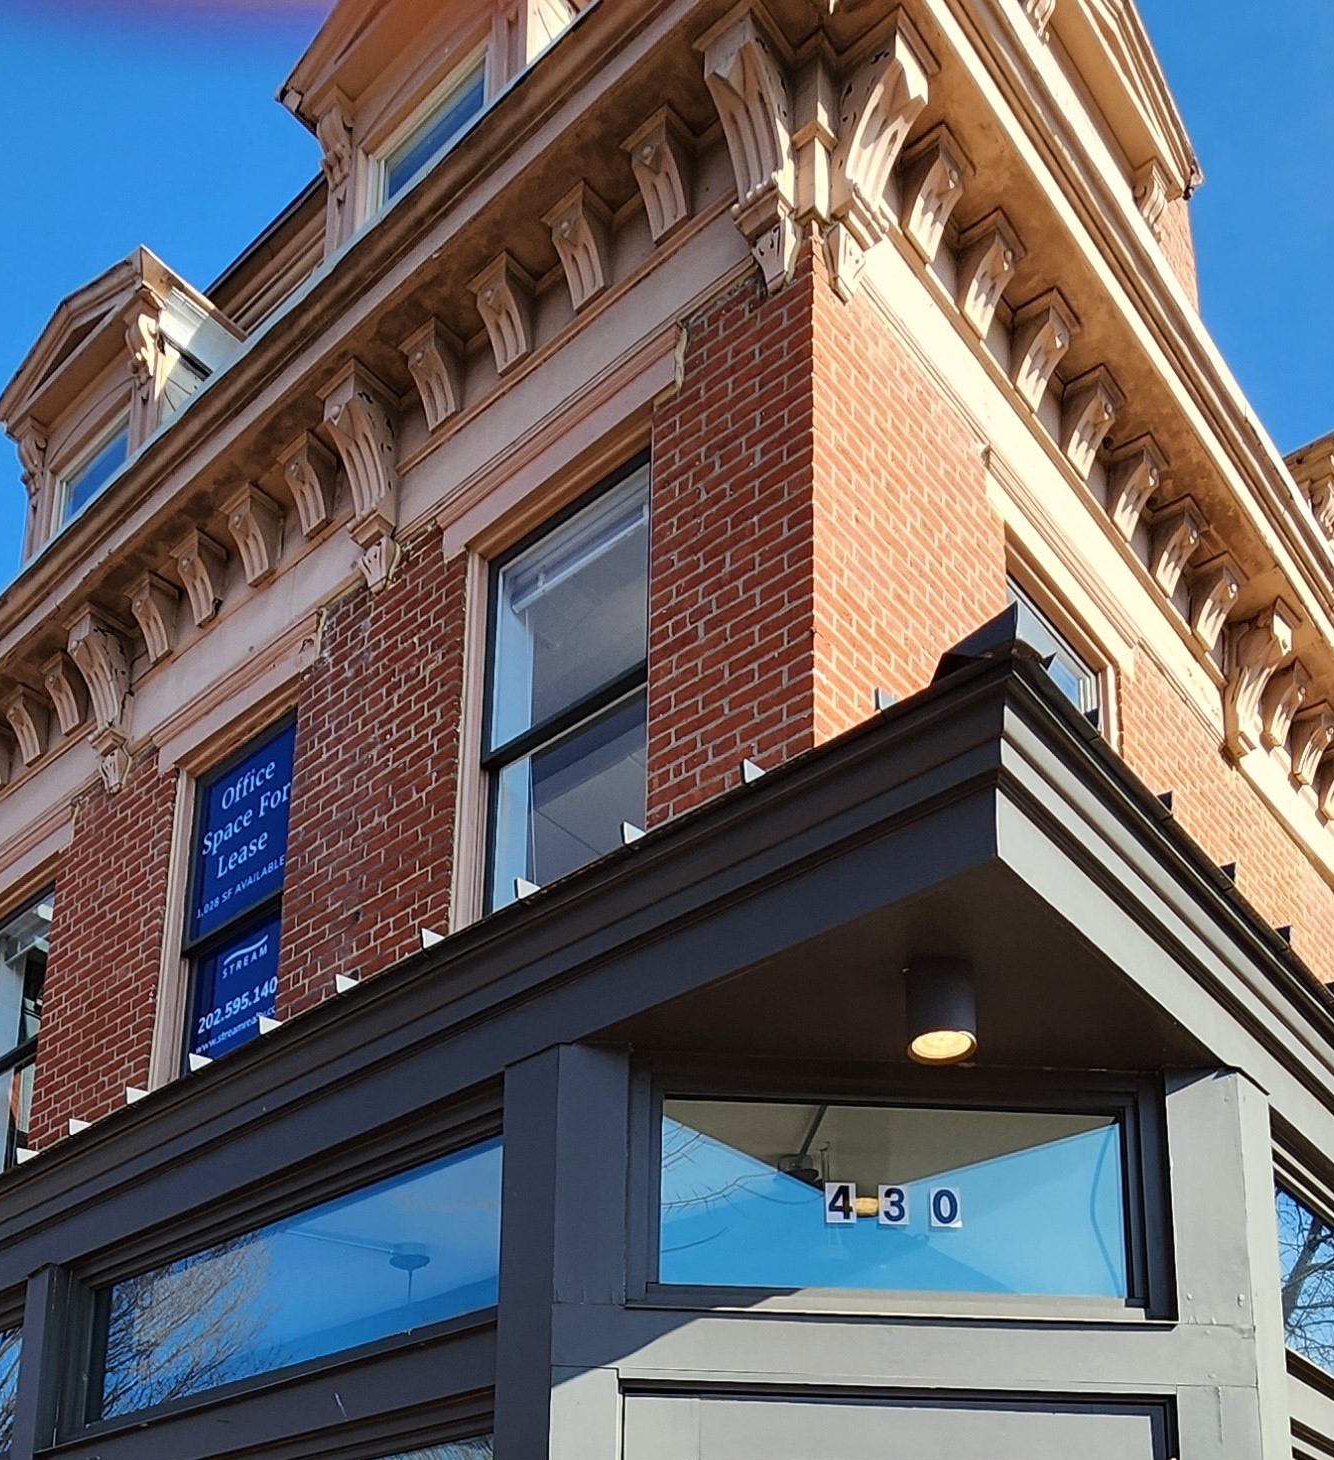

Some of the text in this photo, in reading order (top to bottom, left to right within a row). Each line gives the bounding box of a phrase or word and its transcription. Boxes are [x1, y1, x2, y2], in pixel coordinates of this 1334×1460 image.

[221, 761, 276, 810] Office
[202, 781, 291, 856] Space For
[216, 832, 268, 879] Lease
[196, 854, 286, 919] 1,028 SF AVAILABLE
[222, 943, 268, 979] STREAM
[828, 1185, 958, 1224] 430
